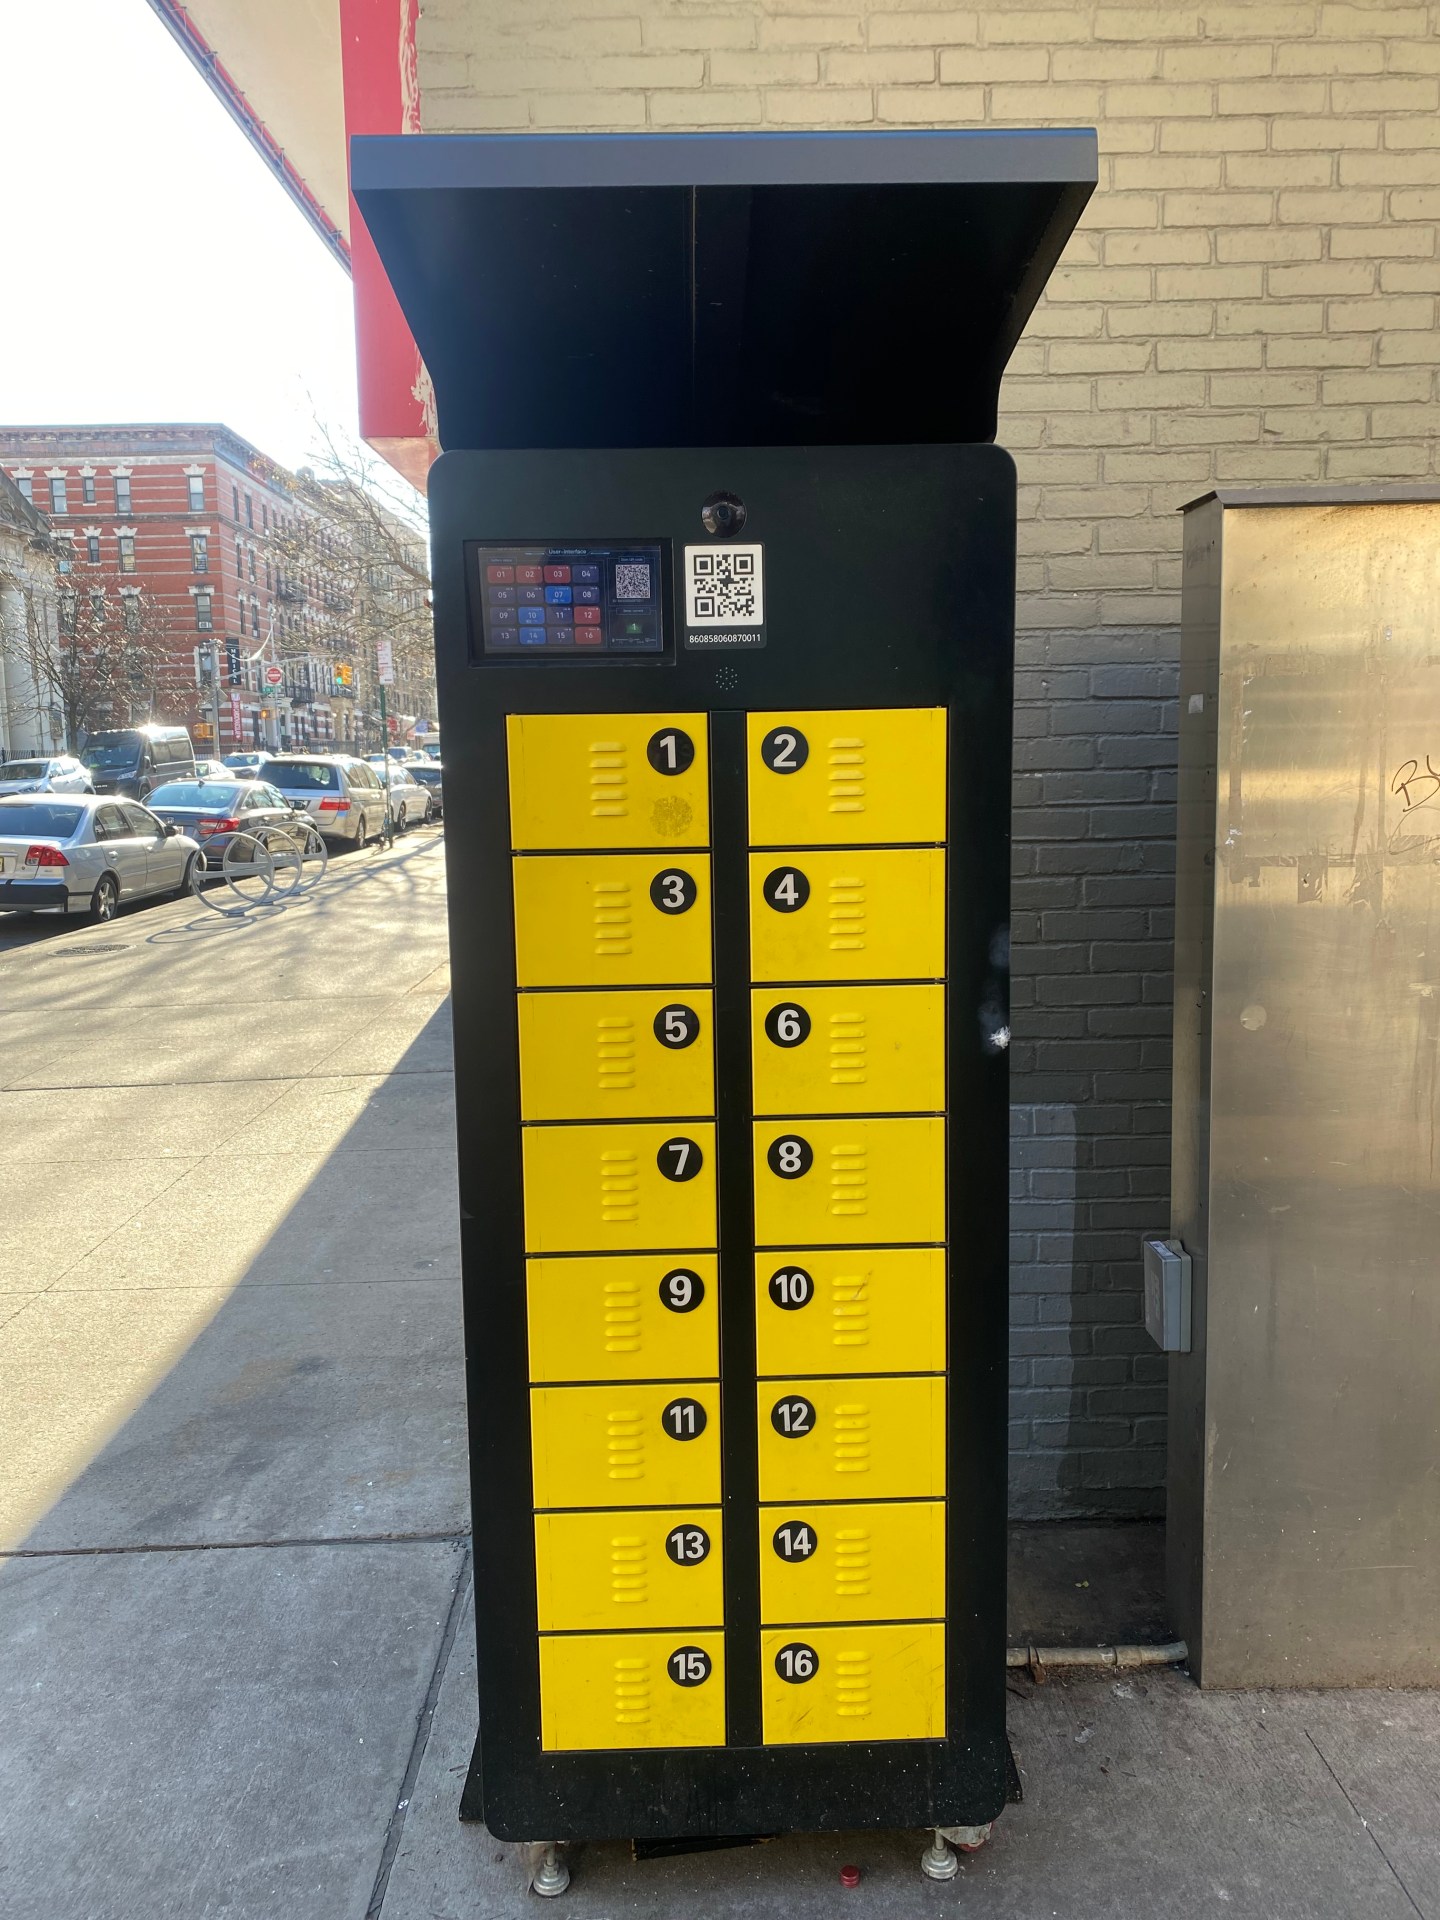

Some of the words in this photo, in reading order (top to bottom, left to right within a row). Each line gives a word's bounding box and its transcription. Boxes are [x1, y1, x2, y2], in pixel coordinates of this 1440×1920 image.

[689, 633, 761, 643] 860858060870011
[659, 735, 677, 769] 1
[773, 733, 797, 768] 2
[662, 875, 685, 908] 3
[774, 873, 799, 906] 4
[665, 1010, 688, 1043] 5
[777, 1009, 801, 1041] 6
[668, 1143, 690, 1176] 7
[778, 1141, 802, 1173] 8
[669, 1275, 692, 1307] 9
[775, 1273, 808, 1303] 10
[669, 1405, 695, 1434] 11
[778, 1402, 810, 1432] 12
[671, 1531, 705, 1560] 13
[778, 1527, 812, 1556] 14
[673, 1652, 706, 1680] 15
[780, 1649, 813, 1677] 16
